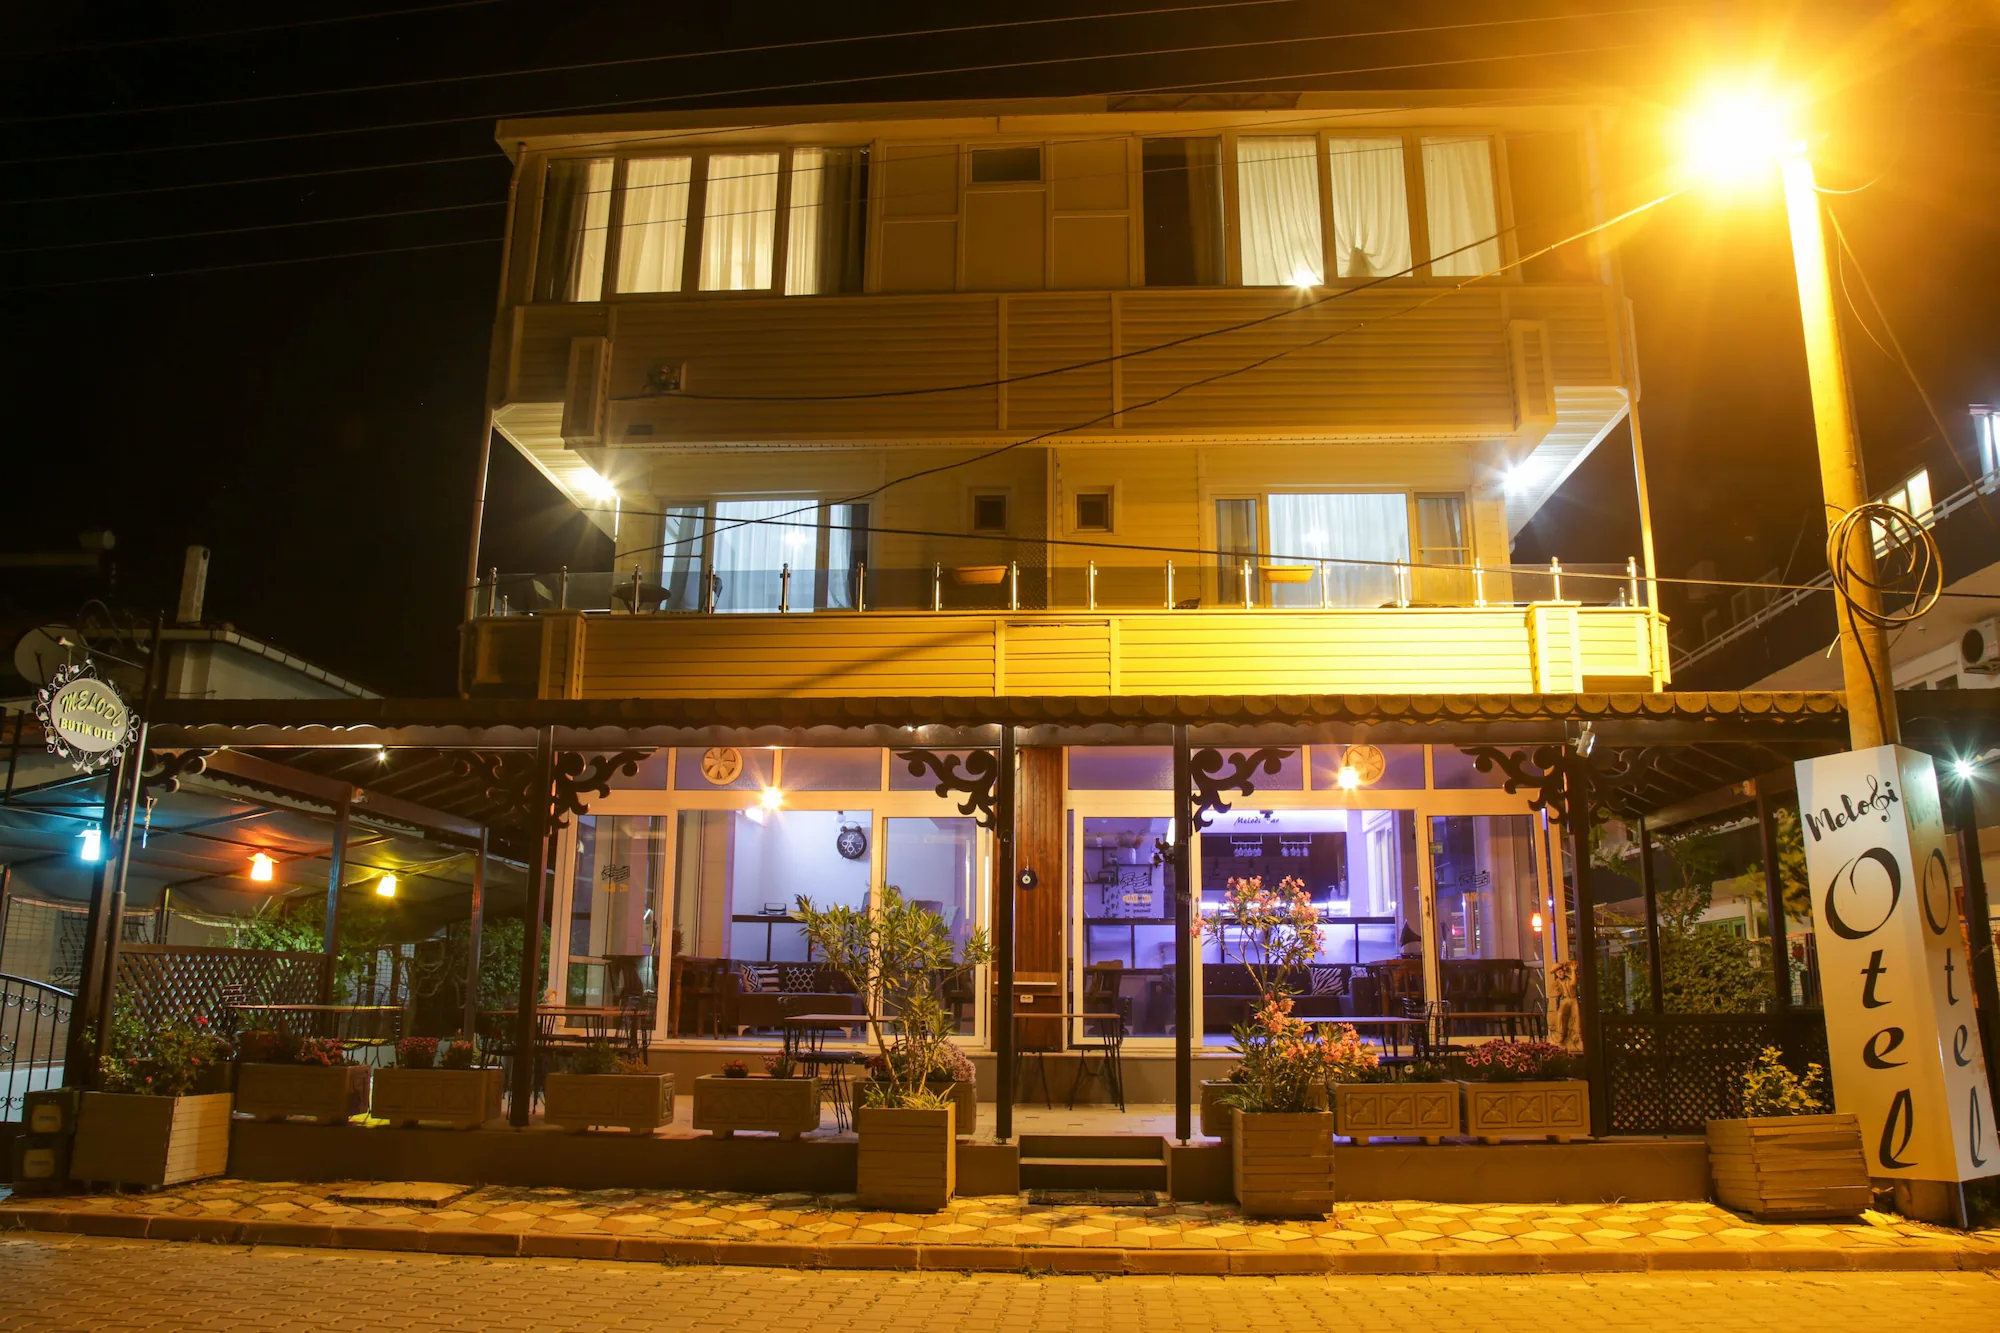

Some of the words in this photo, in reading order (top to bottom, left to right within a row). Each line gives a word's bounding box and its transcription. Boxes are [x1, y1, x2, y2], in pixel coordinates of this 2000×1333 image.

[59, 717, 92, 736] BUTİK
[93, 726, 118, 742] OTEL
[1233, 816, 1261, 826] Melodi
